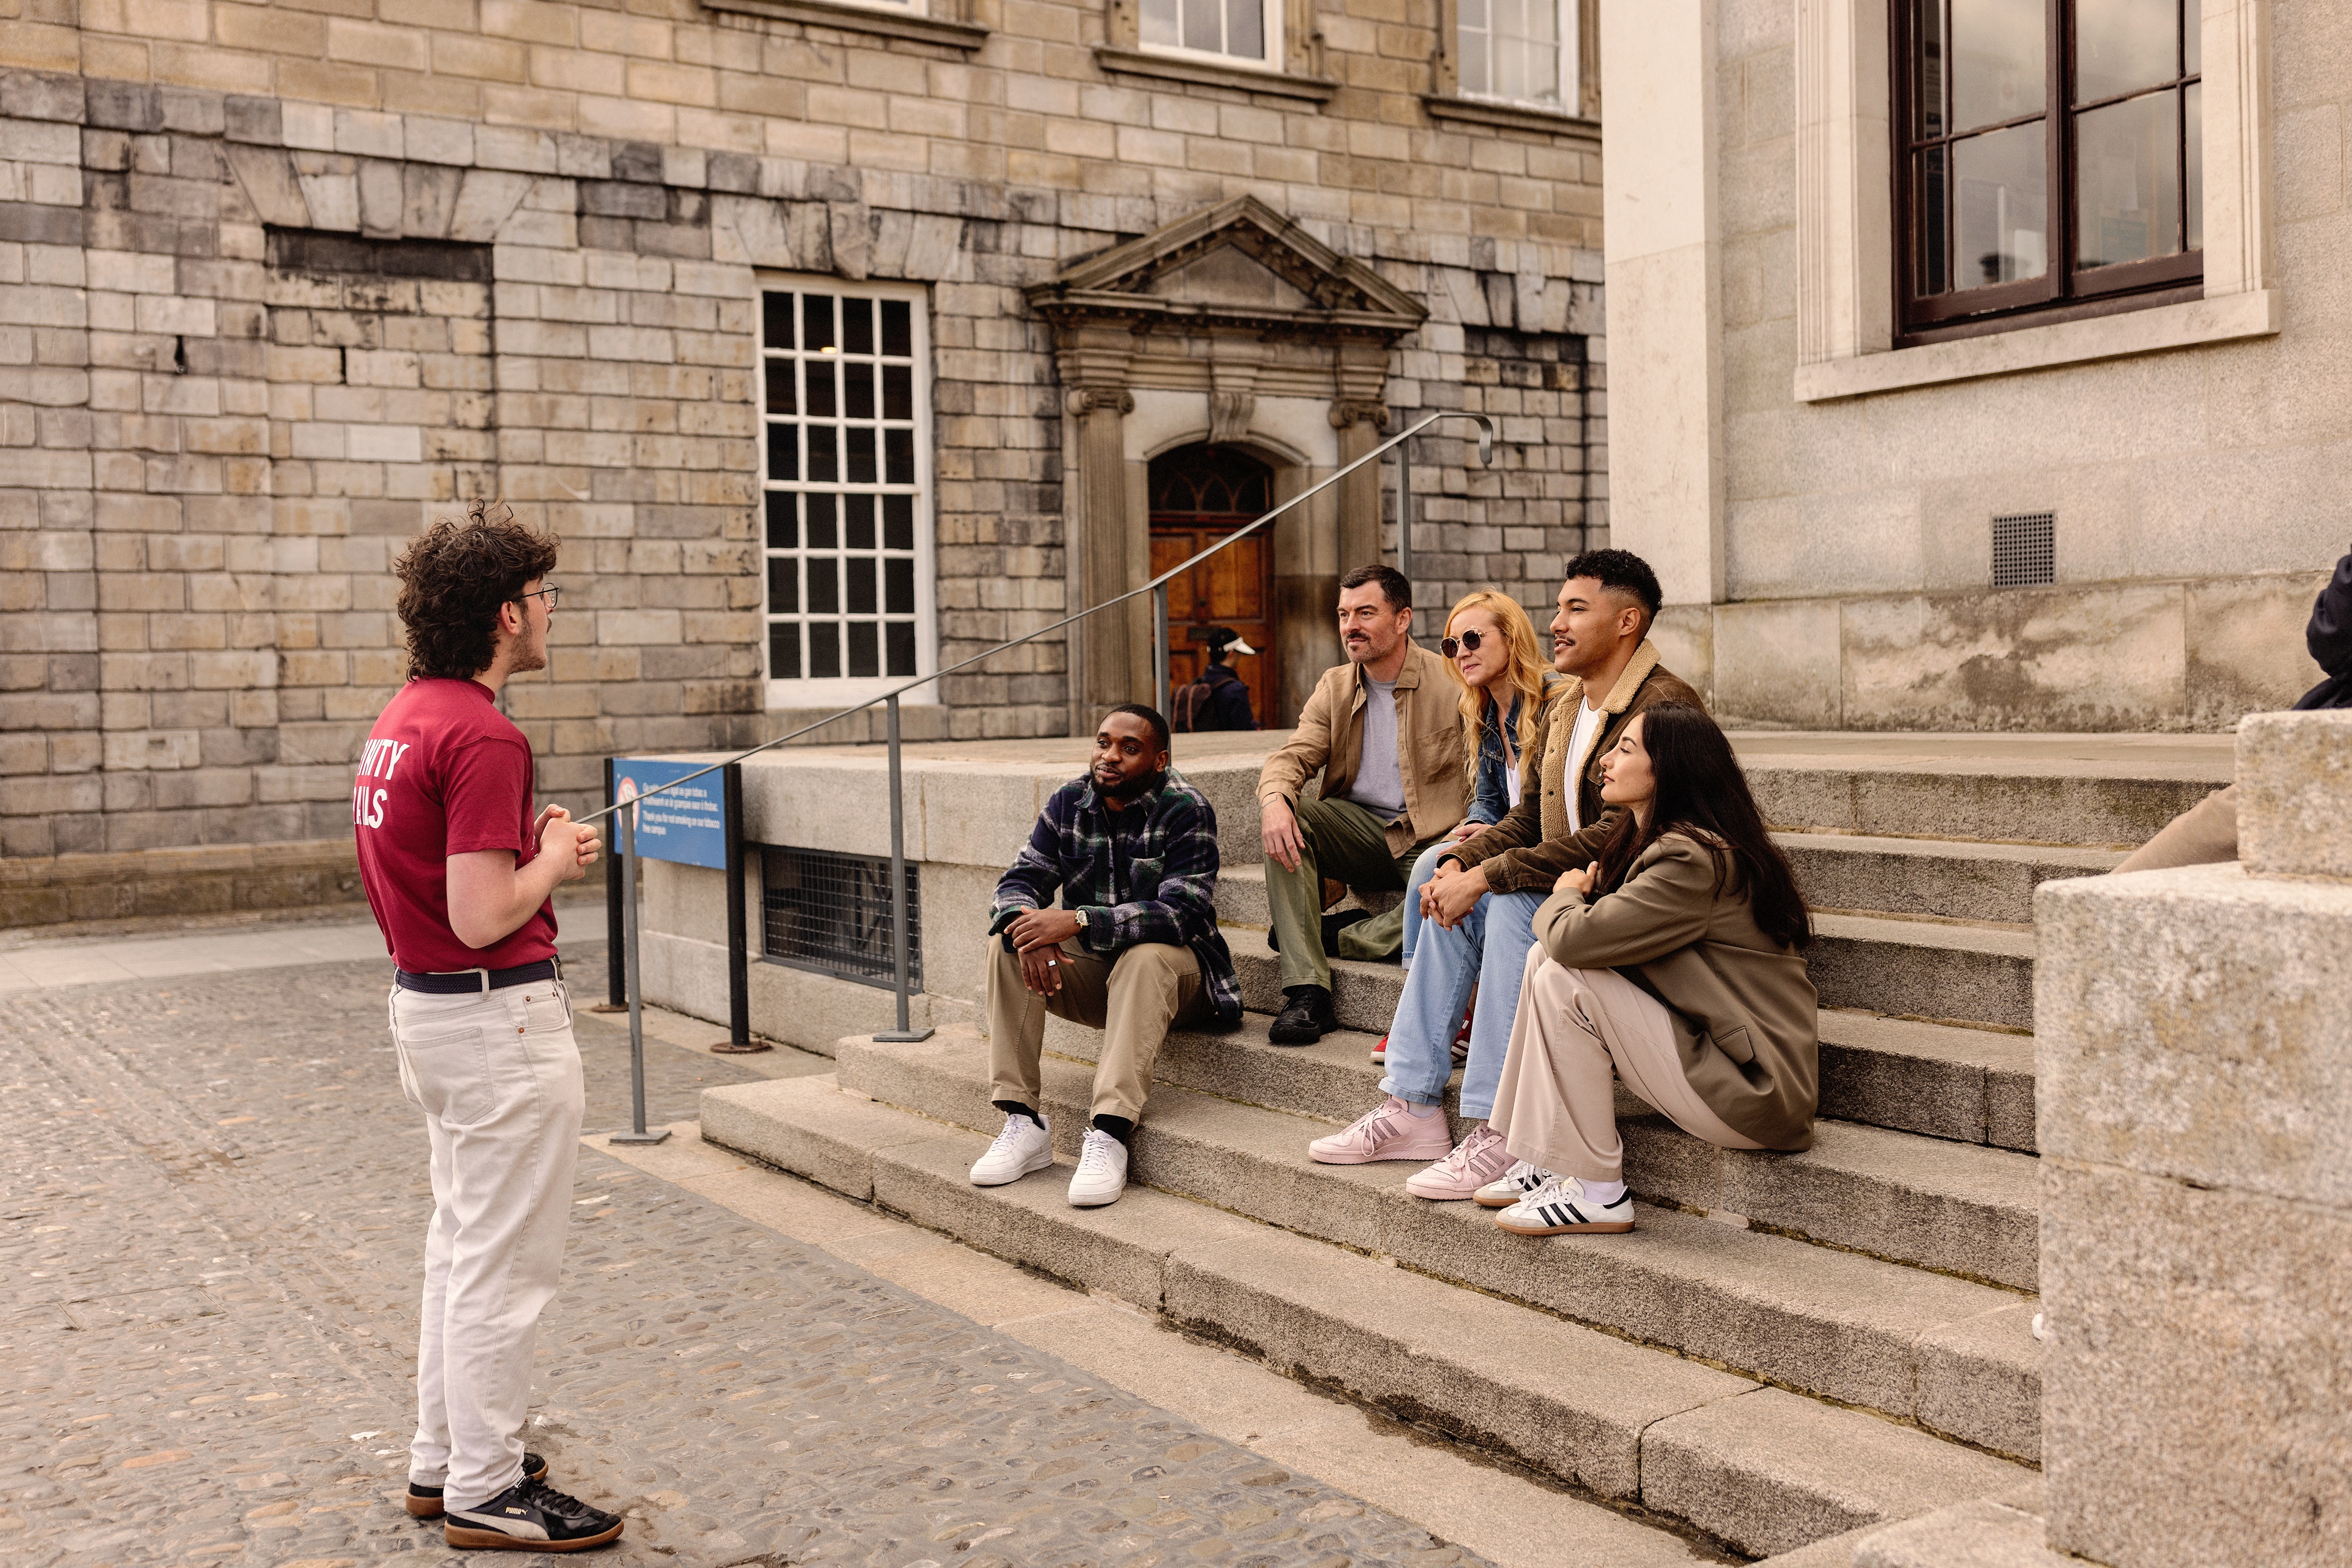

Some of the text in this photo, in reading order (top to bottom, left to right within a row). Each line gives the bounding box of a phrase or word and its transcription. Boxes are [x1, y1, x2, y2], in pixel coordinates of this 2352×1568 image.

[357, 739, 410, 780] INITY
[643, 810, 655, 822] Thank
[675, 815, 692, 828] smoking
[505, 1507, 522, 1515] PUMA
